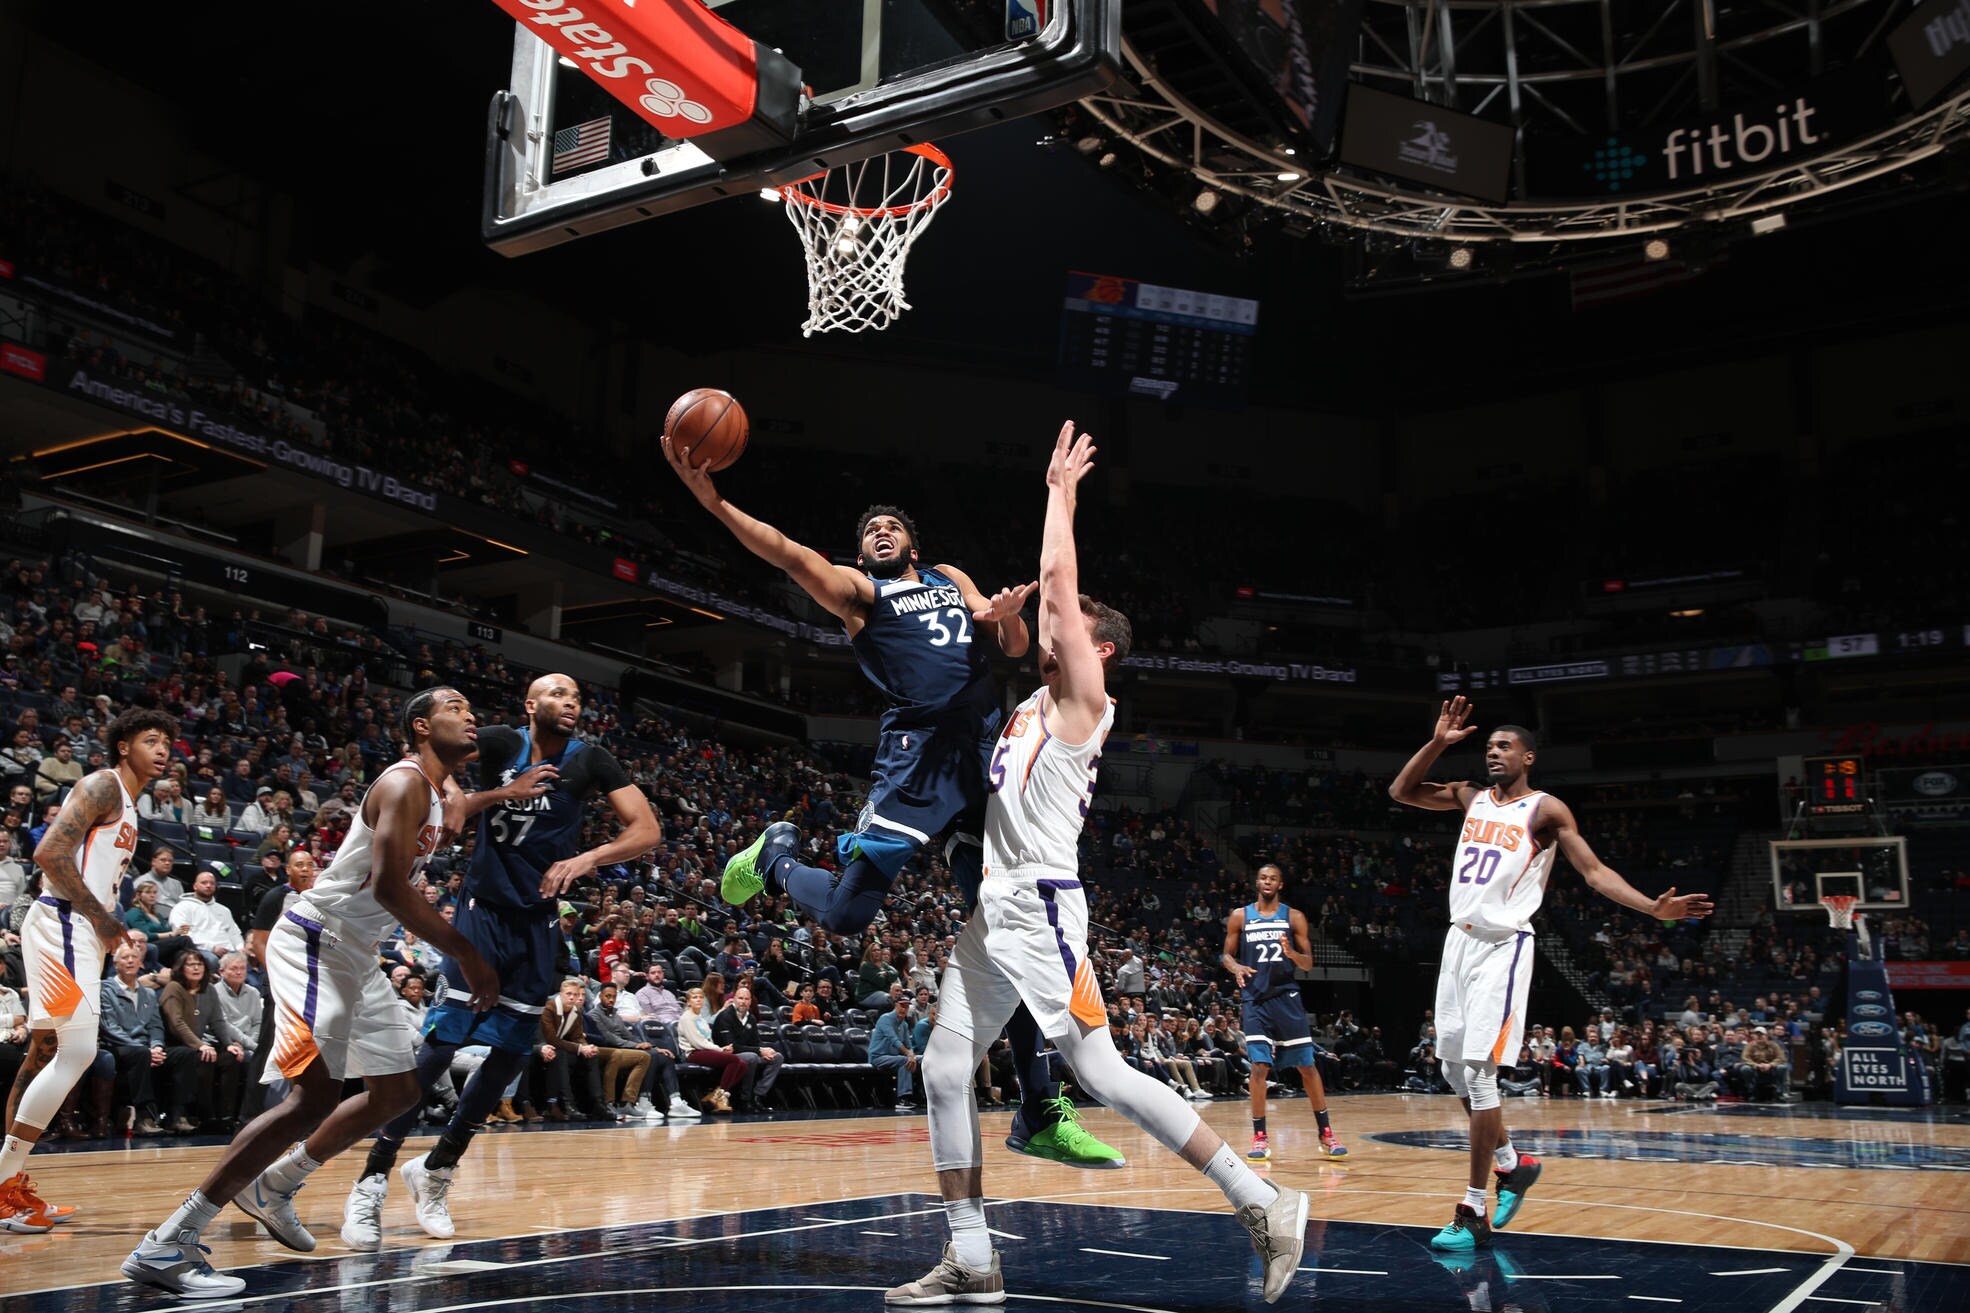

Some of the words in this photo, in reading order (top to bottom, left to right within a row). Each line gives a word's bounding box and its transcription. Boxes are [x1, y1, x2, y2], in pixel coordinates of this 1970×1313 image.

[1011, 15, 1031, 36] NBA
[68, 369, 185, 426] America's
[188, 410, 354, 487] Fastest-Growing
[355, 466, 384, 491] TV
[383, 475, 438, 511] Brand
[224, 566, 248, 583] 112
[475, 625, 494, 640] 113
[918, 608, 972, 646] 32
[1168, 656, 1289, 681] Fastest-Growing
[1289, 664, 1311, 679] TV
[1311, 666, 1356, 682] Brand
[1458, 846, 1502, 885] 20
[1256, 943, 1283, 963] 22
[1851, 1052, 1879, 1063] ALL
[1852, 1064, 1889, 1075] EYES
[1853, 1075, 1907, 1086] NORTH
